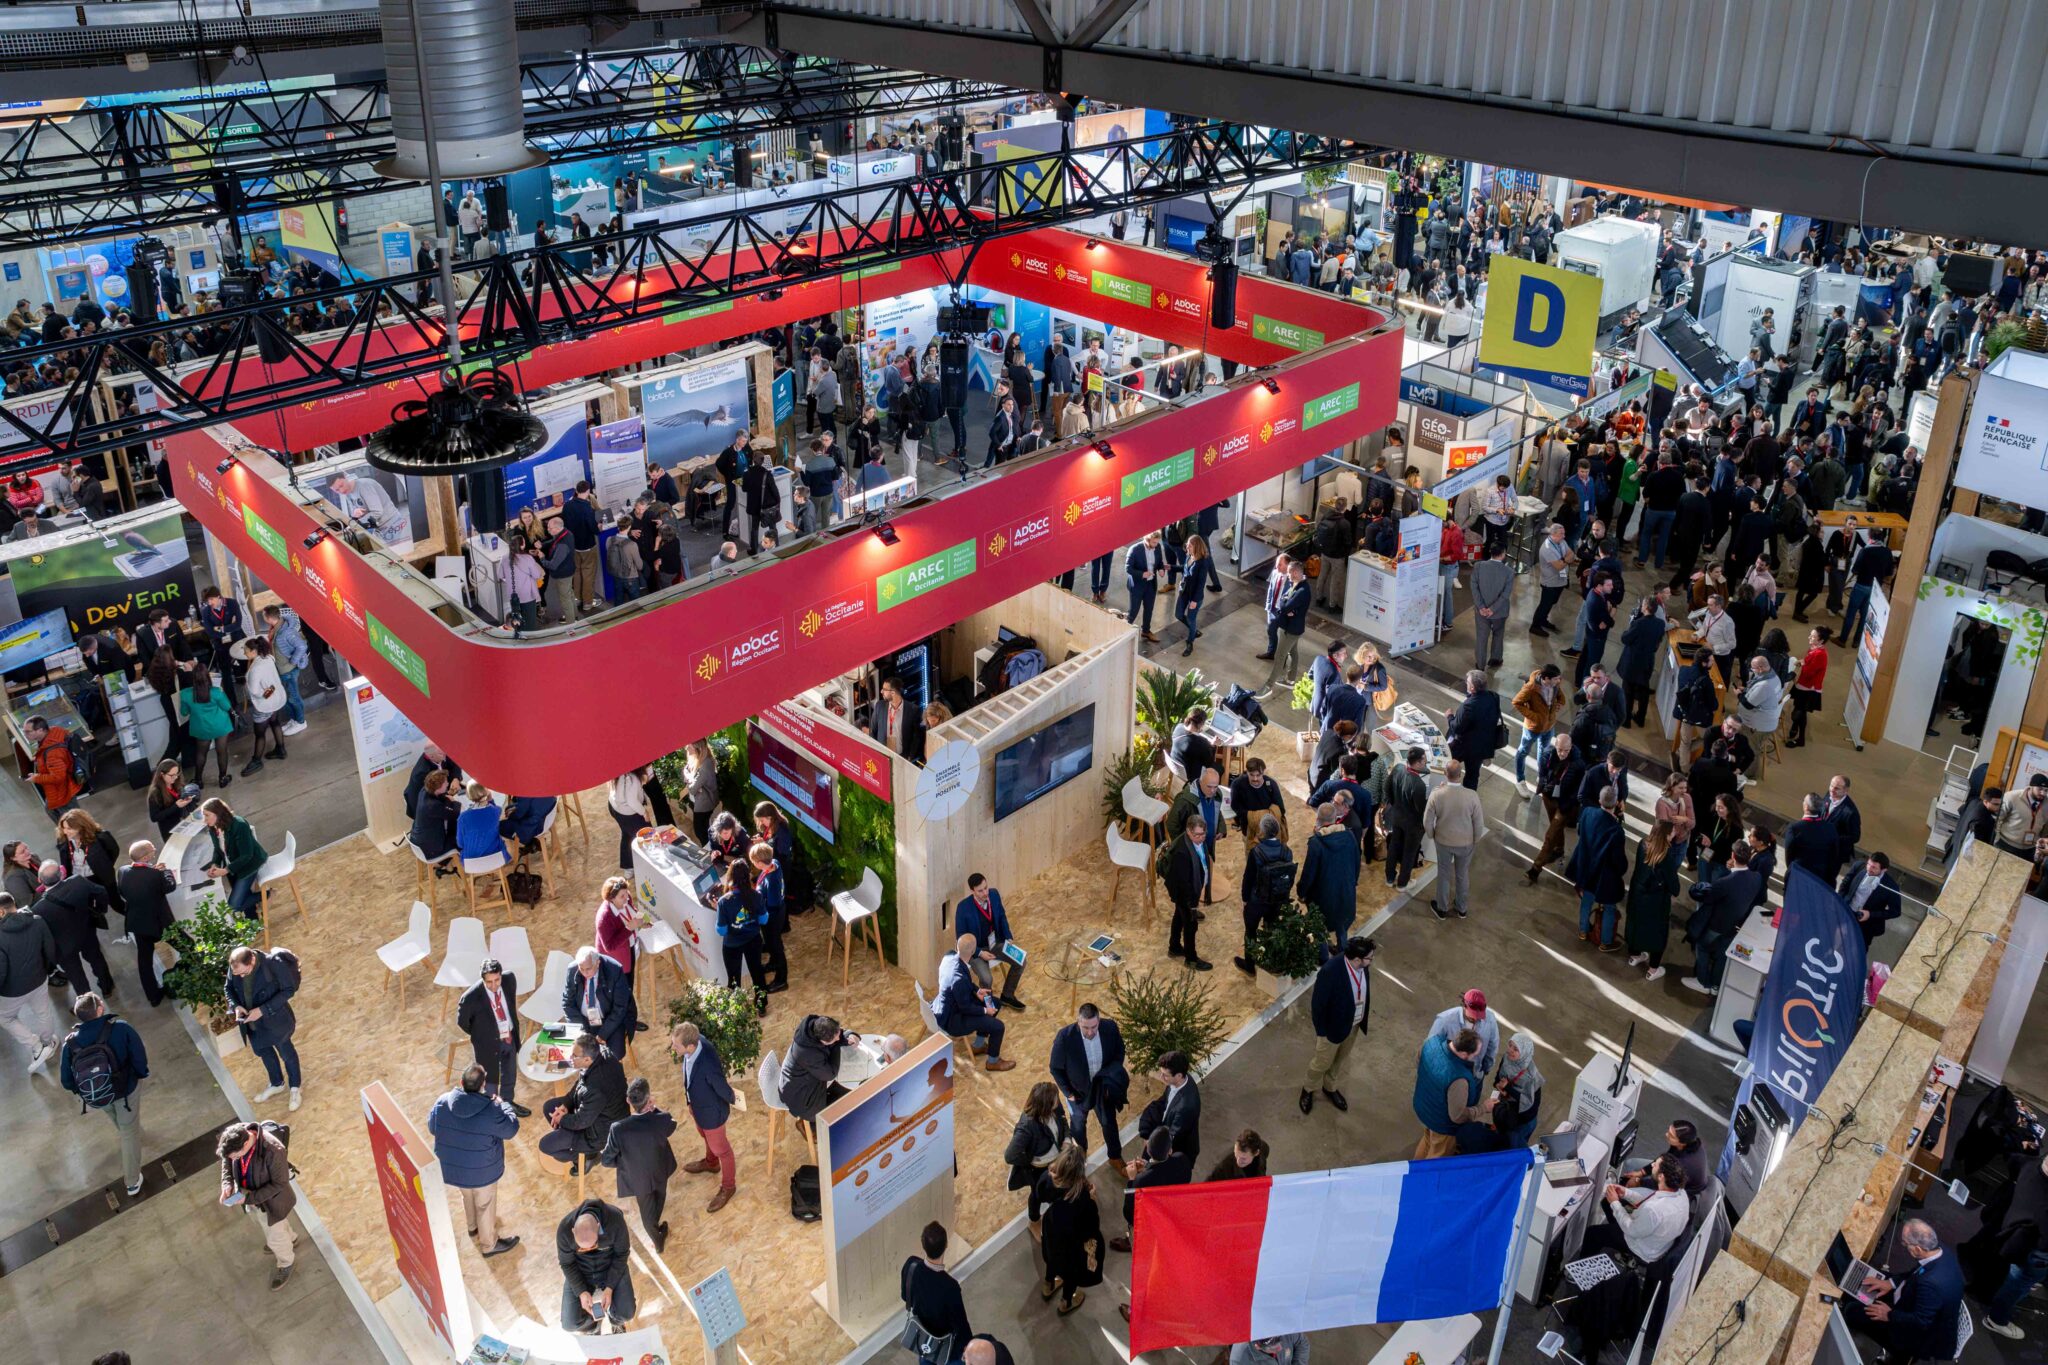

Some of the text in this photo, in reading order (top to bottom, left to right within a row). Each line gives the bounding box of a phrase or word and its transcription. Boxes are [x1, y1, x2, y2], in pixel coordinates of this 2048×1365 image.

[226, 126, 253, 136] SORTIE
[830, 163, 851, 176] GRDF
[872, 161, 898, 175] GRDF
[1015, 162, 1043, 213] C
[1109, 280, 1131, 293] AREC
[1513, 274, 1566, 349] D
[1273, 325, 1300, 340] AREC
[327, 391, 367, 404] Région Occitanie
[1319, 395, 1342, 413] AREC
[1274, 419, 1296, 432] Occitanie
[1984, 424, 2037, 444] RÉPUBLIQUE
[1223, 433, 1249, 453] AD'OCC
[1983, 432, 2031, 450] FRANÇAISE
[1143, 465, 1172, 486] AREC
[1148, 479, 1170, 492] Occitanie
[1083, 496, 1111, 512] Occitanie
[255, 521, 273, 545] AREC
[1014, 516, 1049, 540] AD'OCC
[1014, 529, 1049, 546] Région Occitanie
[305, 566, 327, 591] AD'OCC
[907, 559, 944, 586] AREC
[914, 575, 945, 592] Occitanie
[86, 582, 180, 627] Dev'EnR
[825, 600, 864, 621] Occitanie
[831, 601, 847, 611] Région
[384, 635, 407, 663] AREC
[731, 629, 779, 659] AD'OCC
[731, 643, 779, 668] Région Occitanie
[783, 721, 790, 731] CE
[790, 725, 803, 739] DÉFI
[803, 734, 831, 758] SOLIDAIRE
[936, 761, 960, 778] ENSEMBLE
[936, 767, 961, 783] DEVENONS
[936, 781, 961, 799] POSITIVE
